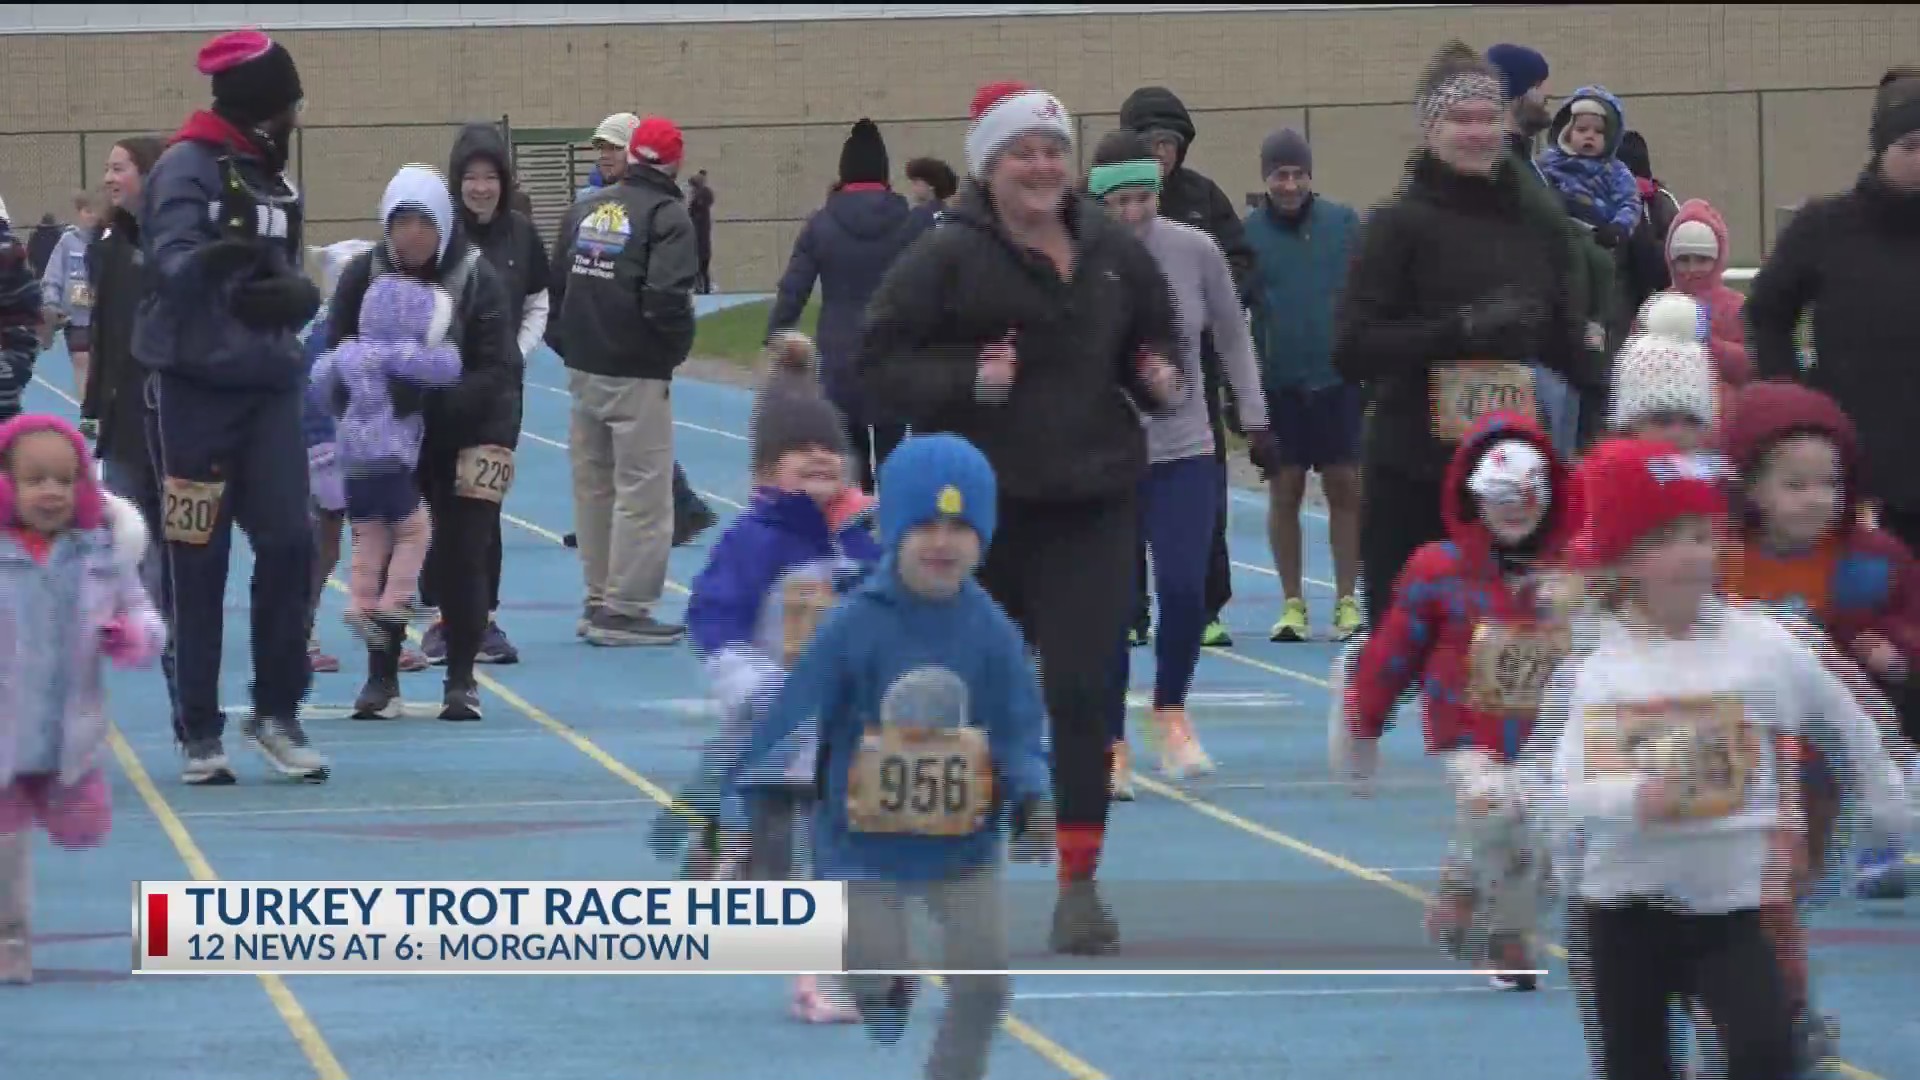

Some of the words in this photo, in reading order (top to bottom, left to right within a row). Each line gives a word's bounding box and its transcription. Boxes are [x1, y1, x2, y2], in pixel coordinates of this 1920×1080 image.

[575, 254, 591, 265] The
[474, 457, 514, 493] 229
[166, 493, 210, 532] 230
[880, 756, 967, 813] 956
